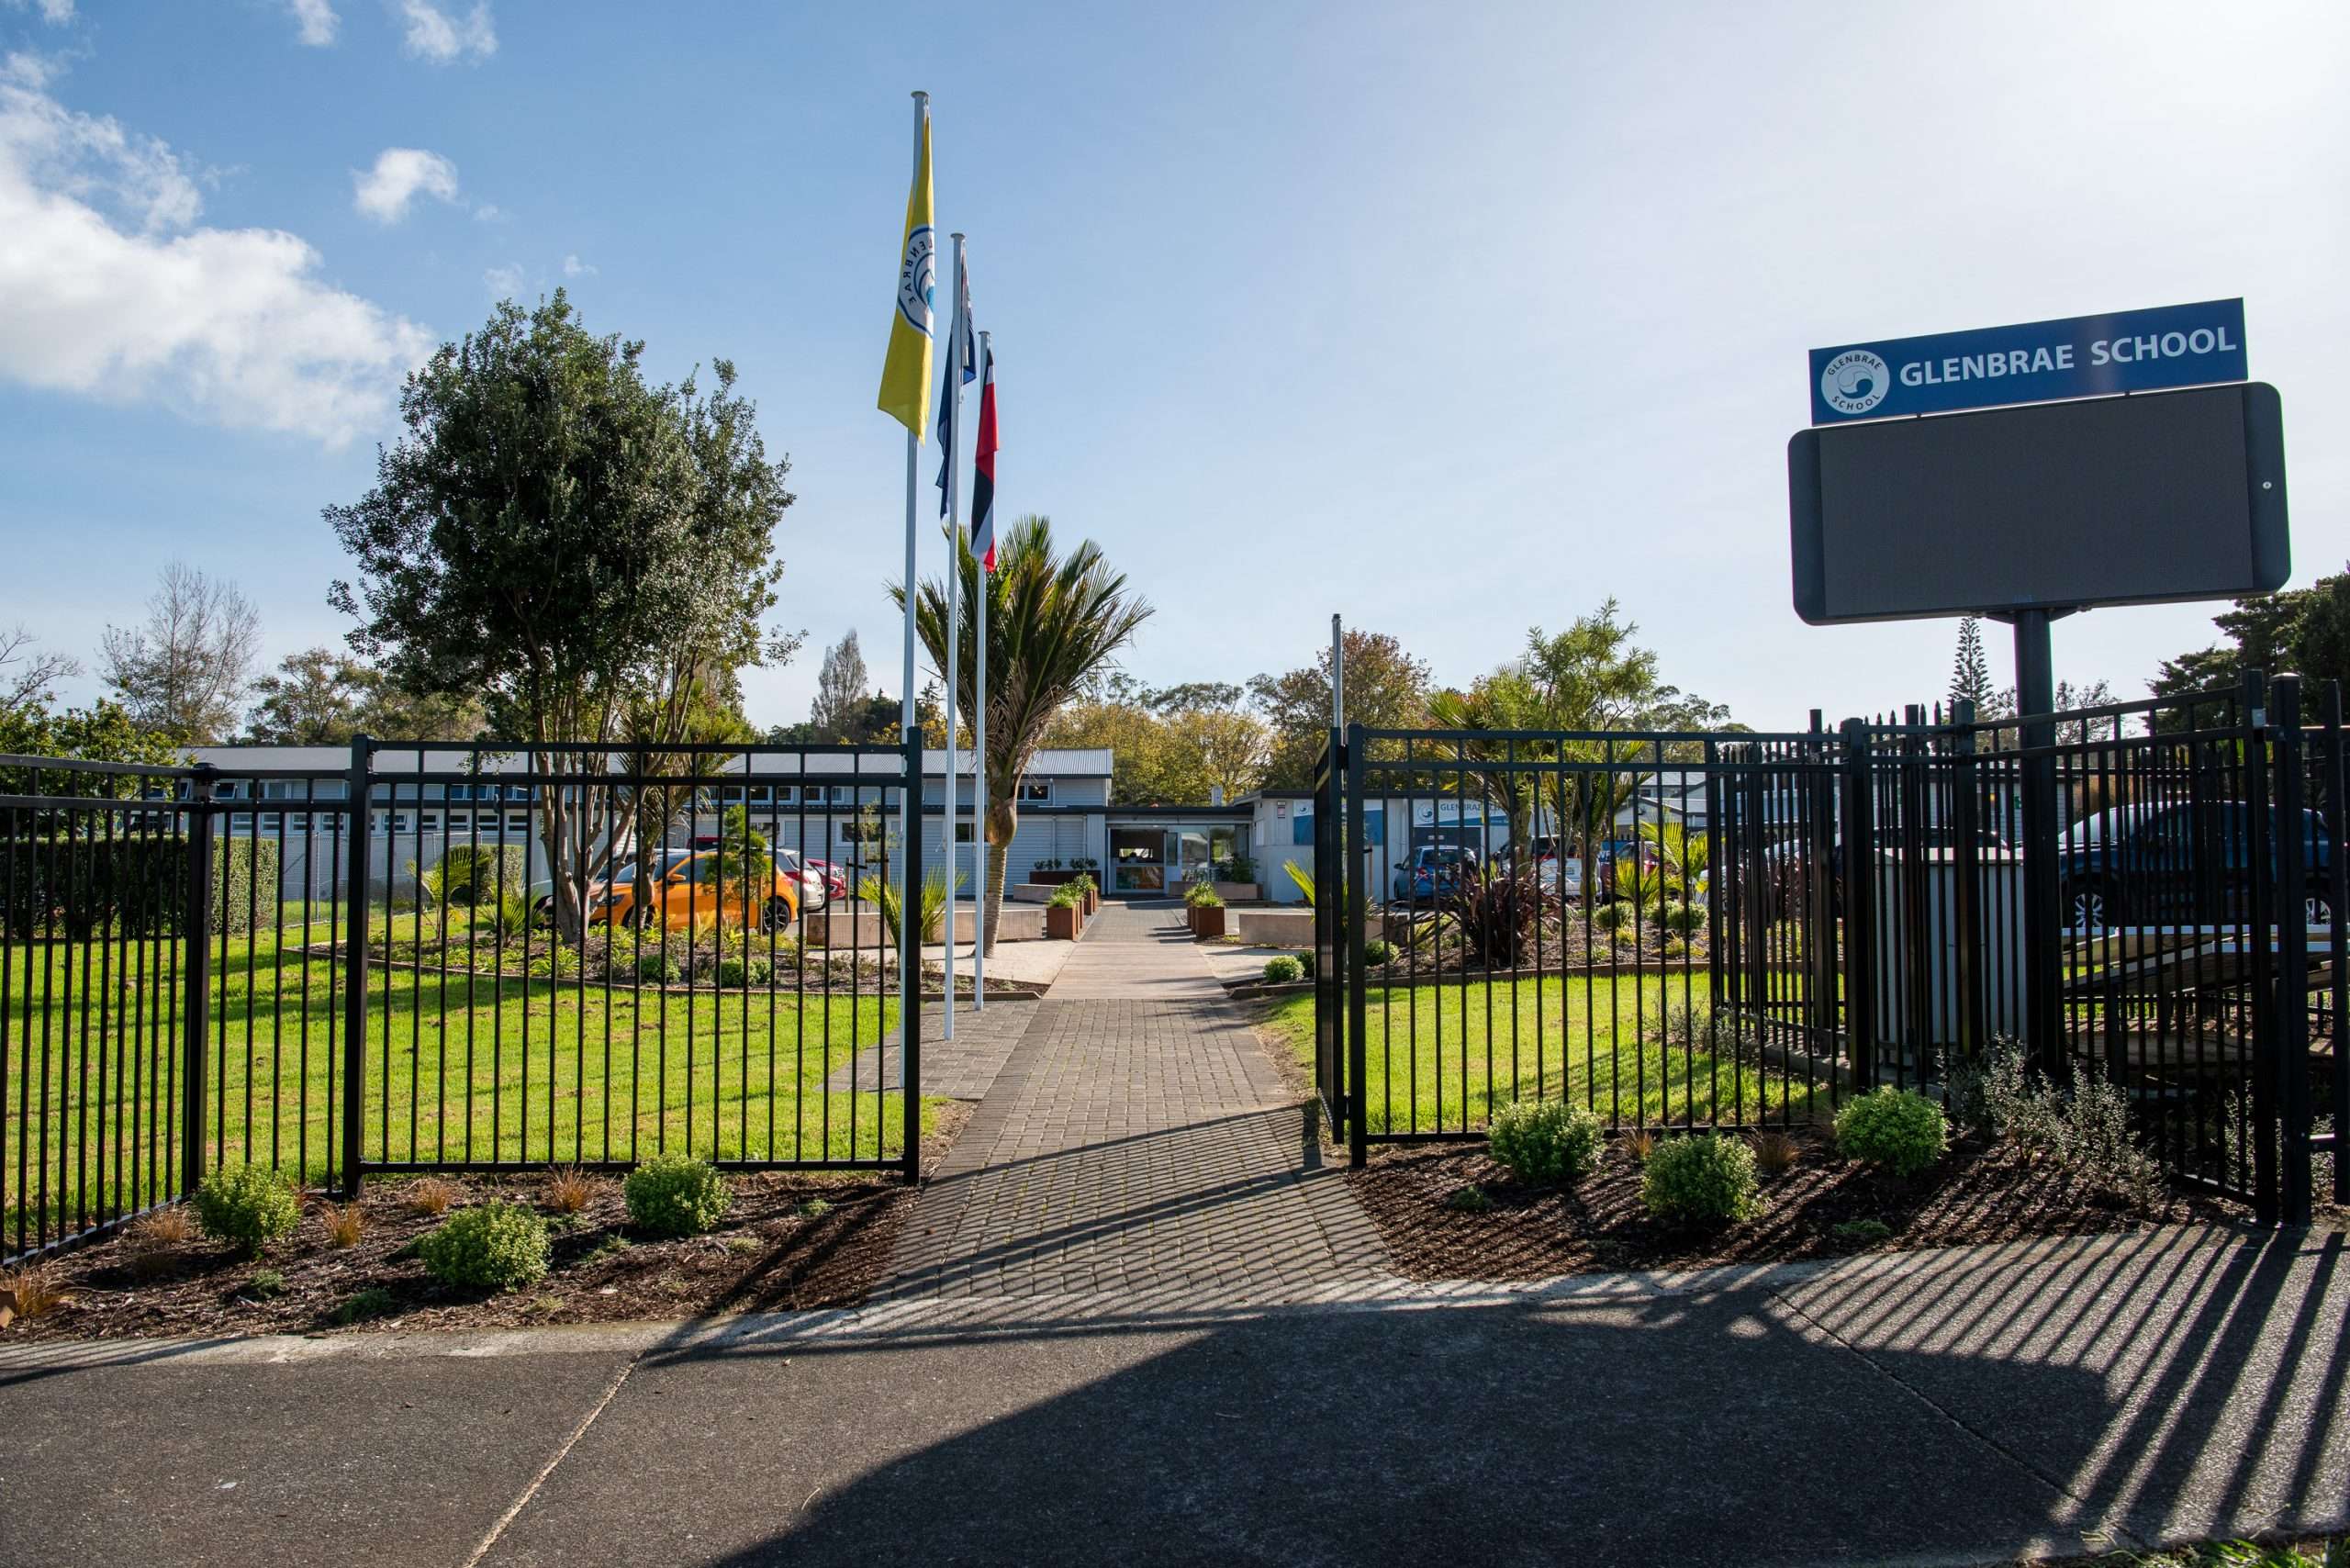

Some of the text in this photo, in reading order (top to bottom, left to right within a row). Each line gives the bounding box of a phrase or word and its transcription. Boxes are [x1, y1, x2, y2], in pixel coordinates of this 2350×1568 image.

[1828, 353, 1883, 375] GLENBRAE
[1899, 326, 2237, 387] GLENBRAE SCHOOL
[1831, 395, 1881, 410] SCHOOL
